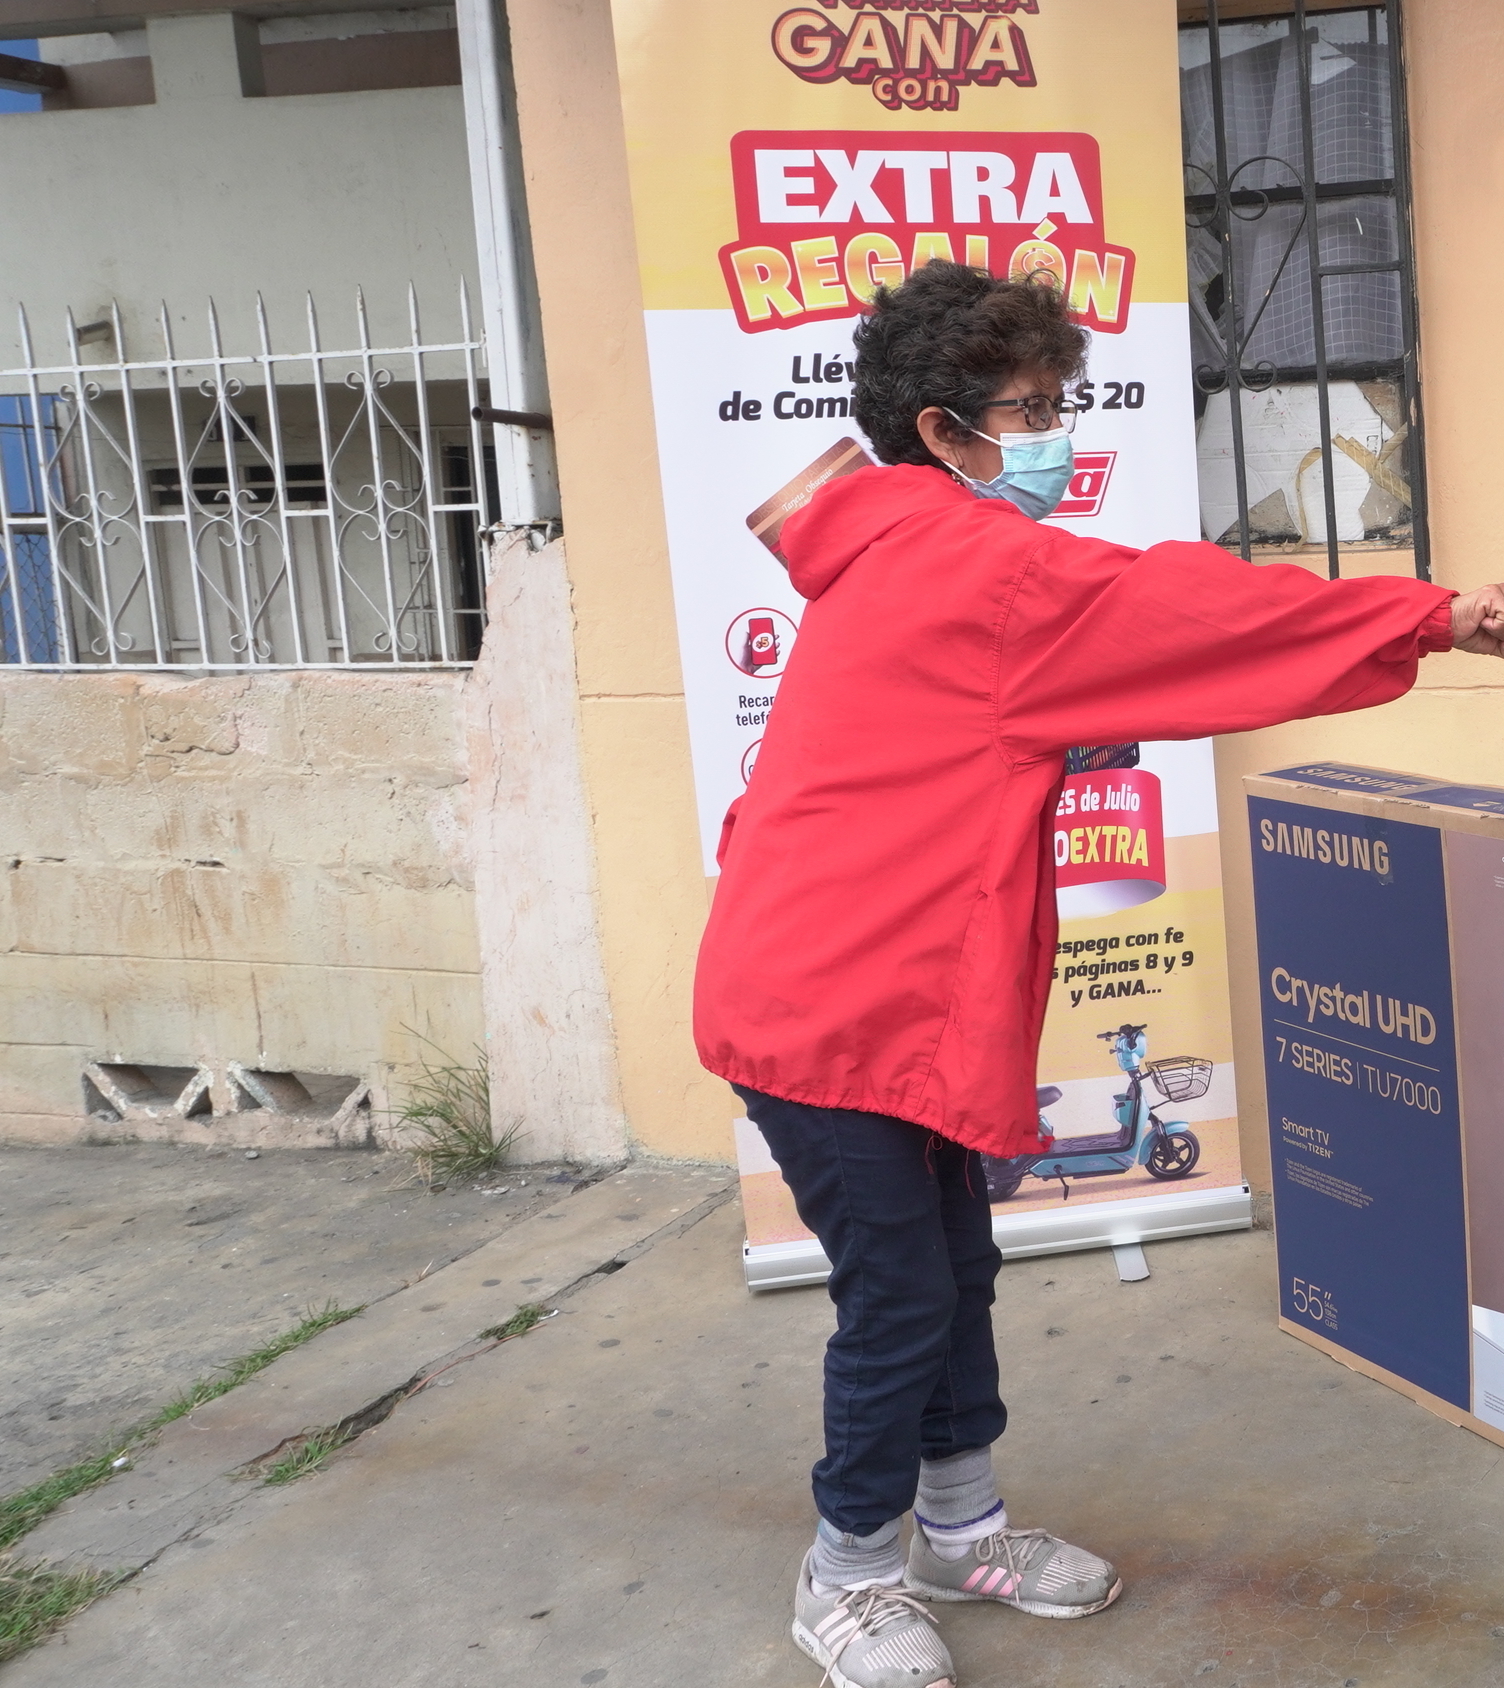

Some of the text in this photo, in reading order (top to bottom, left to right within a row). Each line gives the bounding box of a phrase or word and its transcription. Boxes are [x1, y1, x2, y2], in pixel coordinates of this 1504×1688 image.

[772, 8, 1033, 83] GANA
[873, 75, 957, 108] con
[754, 149, 1094, 225] EXTRA
[719, 391, 762, 421] de
[1102, 382, 1145, 410] 20
[781, 492, 805, 513] Tarjeta
[805, 468, 835, 494] Obsequio
[1296, 767, 1421, 792] SAMSUNG
[1080, 785, 1100, 812] de
[1103, 783, 1140, 812] Julio
[1260, 819, 1390, 876] SAMSUNG
[1125, 932, 1159, 948] con
[1164, 927, 1185, 944] fe
[1063, 958, 1140, 984] páginas
[1145, 953, 1158, 970] 8
[1163, 955, 1176, 974] y
[1181, 950, 1194, 967] 9
[1070, 979, 1162, 1008] y GANA...
[1271, 966, 1437, 1046] Crystal UHD
[1276, 1036, 1442, 1116] 7 SERIES TU7000
[1282, 1117, 1330, 1146] Smart TV
[798, 1634, 815, 1653] adidas
